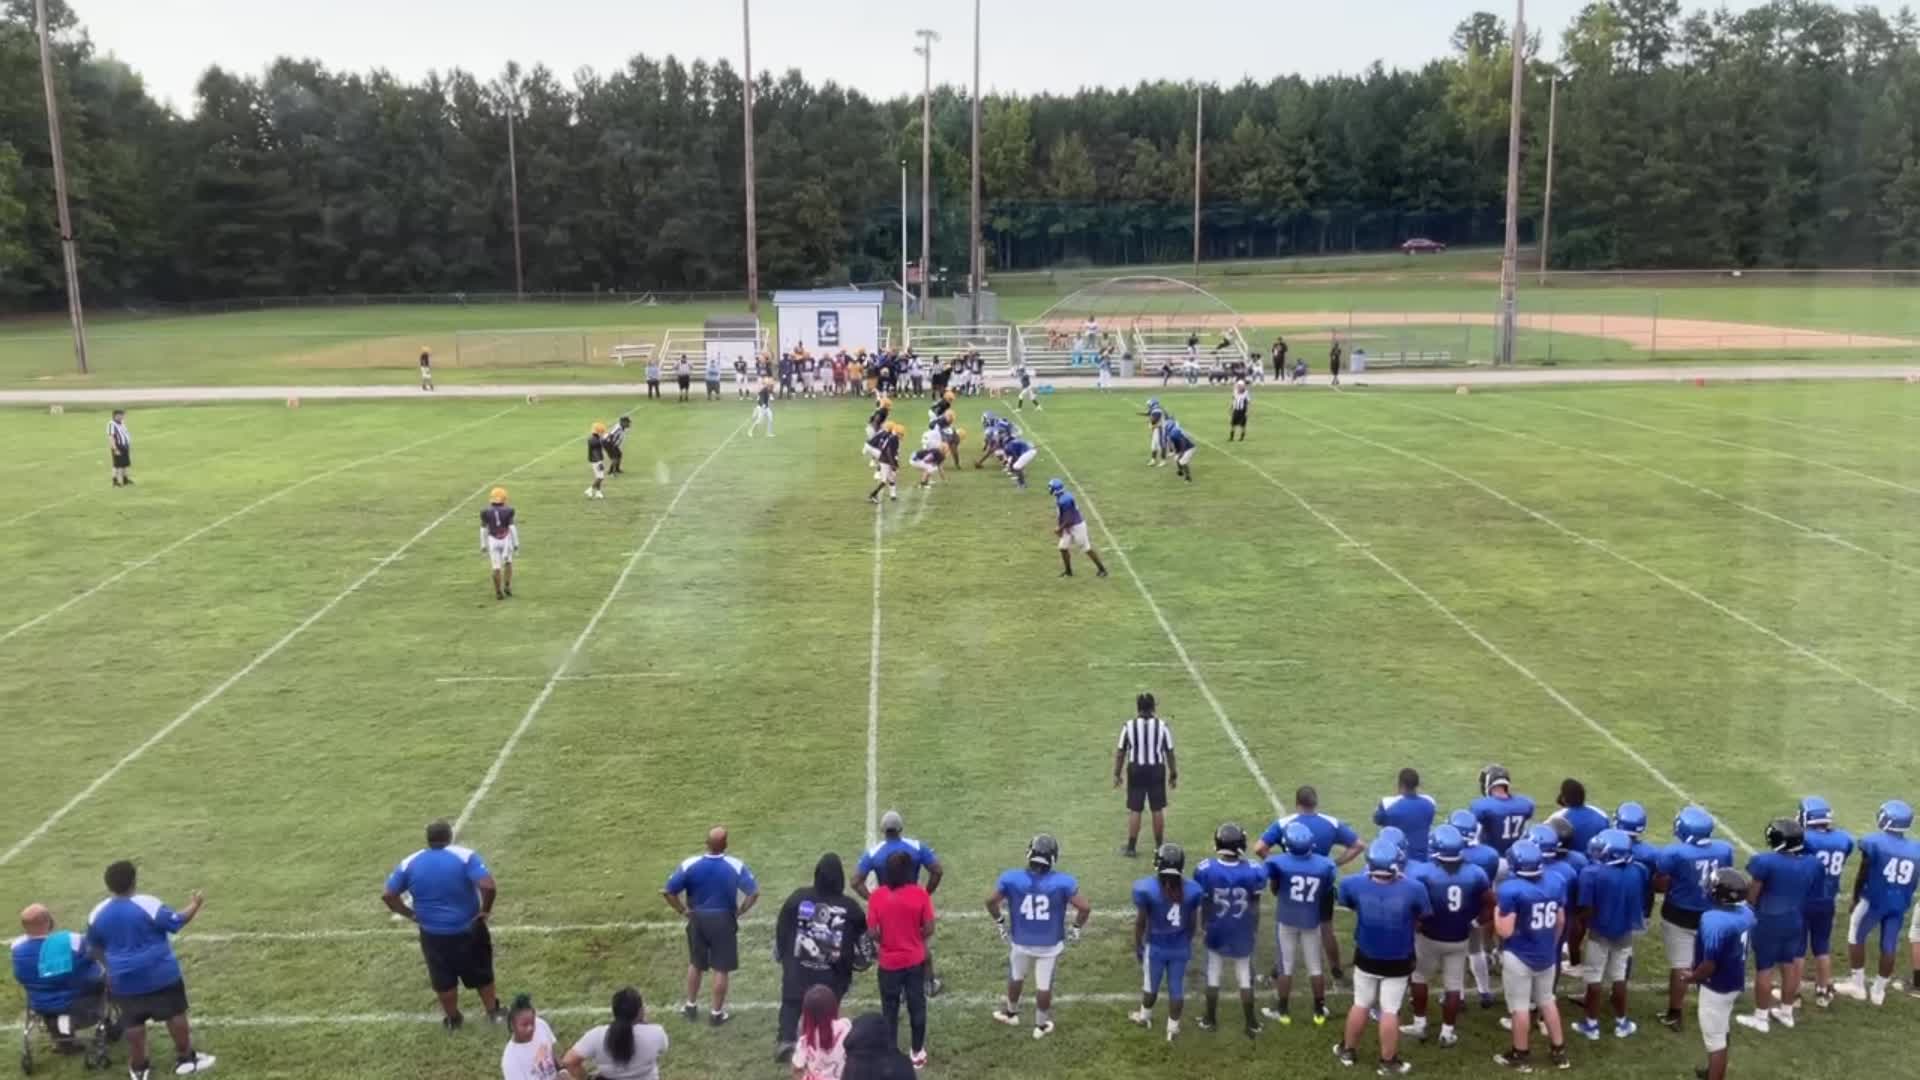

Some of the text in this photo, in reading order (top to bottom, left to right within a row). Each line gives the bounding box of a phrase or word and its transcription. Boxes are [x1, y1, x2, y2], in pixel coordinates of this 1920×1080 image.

[1502, 815, 1523, 840] 17
[1883, 857, 1914, 884] 49
[1290, 876, 1321, 902] 27
[1447, 886, 1462, 912] 9
[1020, 894, 1050, 921] 42
[1166, 904, 1181, 926] 4
[1212, 887, 1249, 918] 53
[1530, 902, 1557, 930] 56
